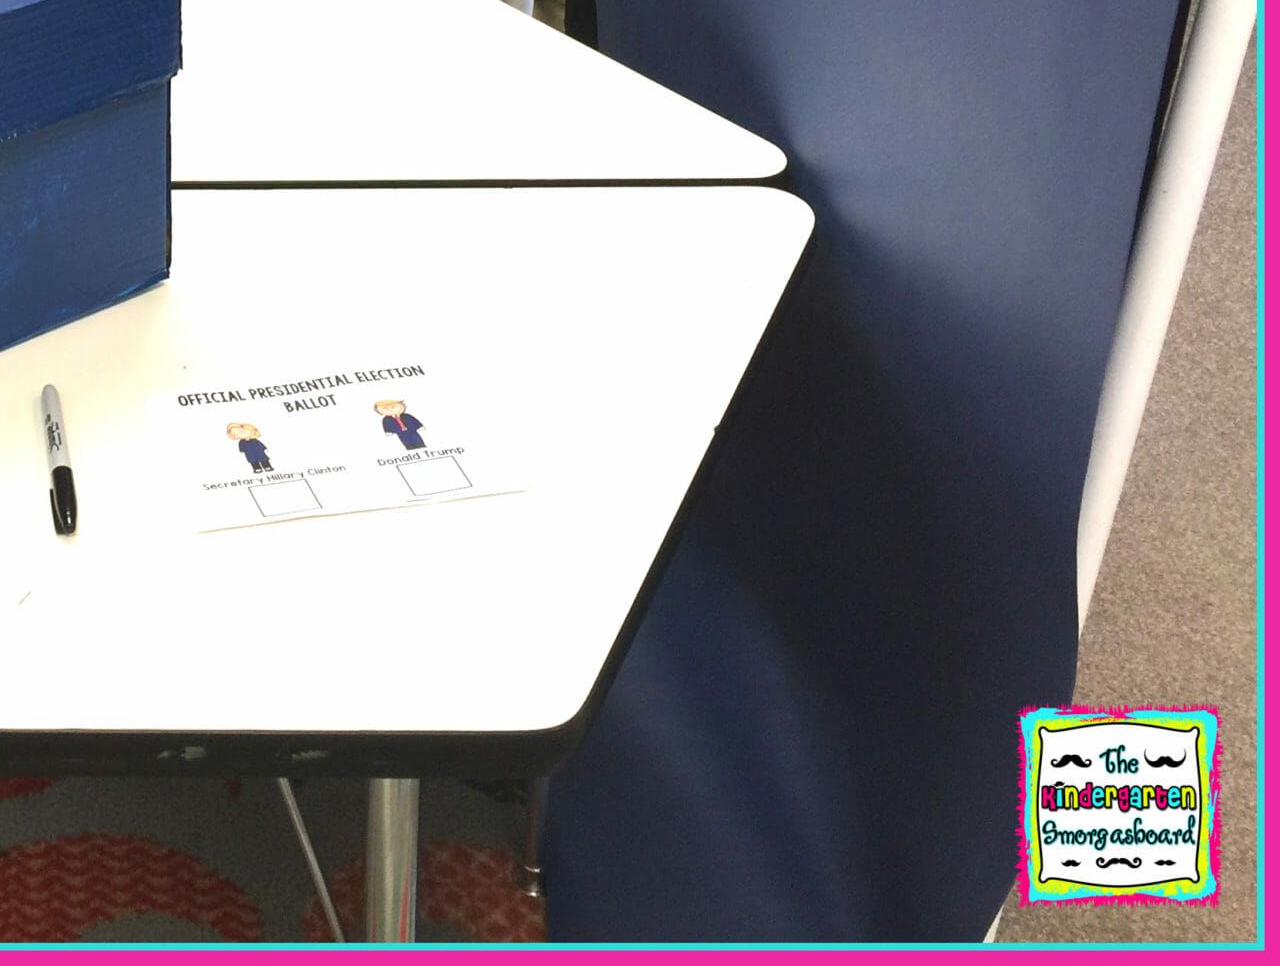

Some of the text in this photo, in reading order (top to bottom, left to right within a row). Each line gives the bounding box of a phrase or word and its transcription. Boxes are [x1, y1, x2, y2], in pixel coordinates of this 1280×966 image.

[178, 365, 425, 407] OFFICIAL PRESIDENTIAL ELECTION
[283, 394, 337, 412] BALLOT
[377, 447, 465, 466] Donald Trump
[202, 465, 347, 491] Secretary Hillary Clinton
